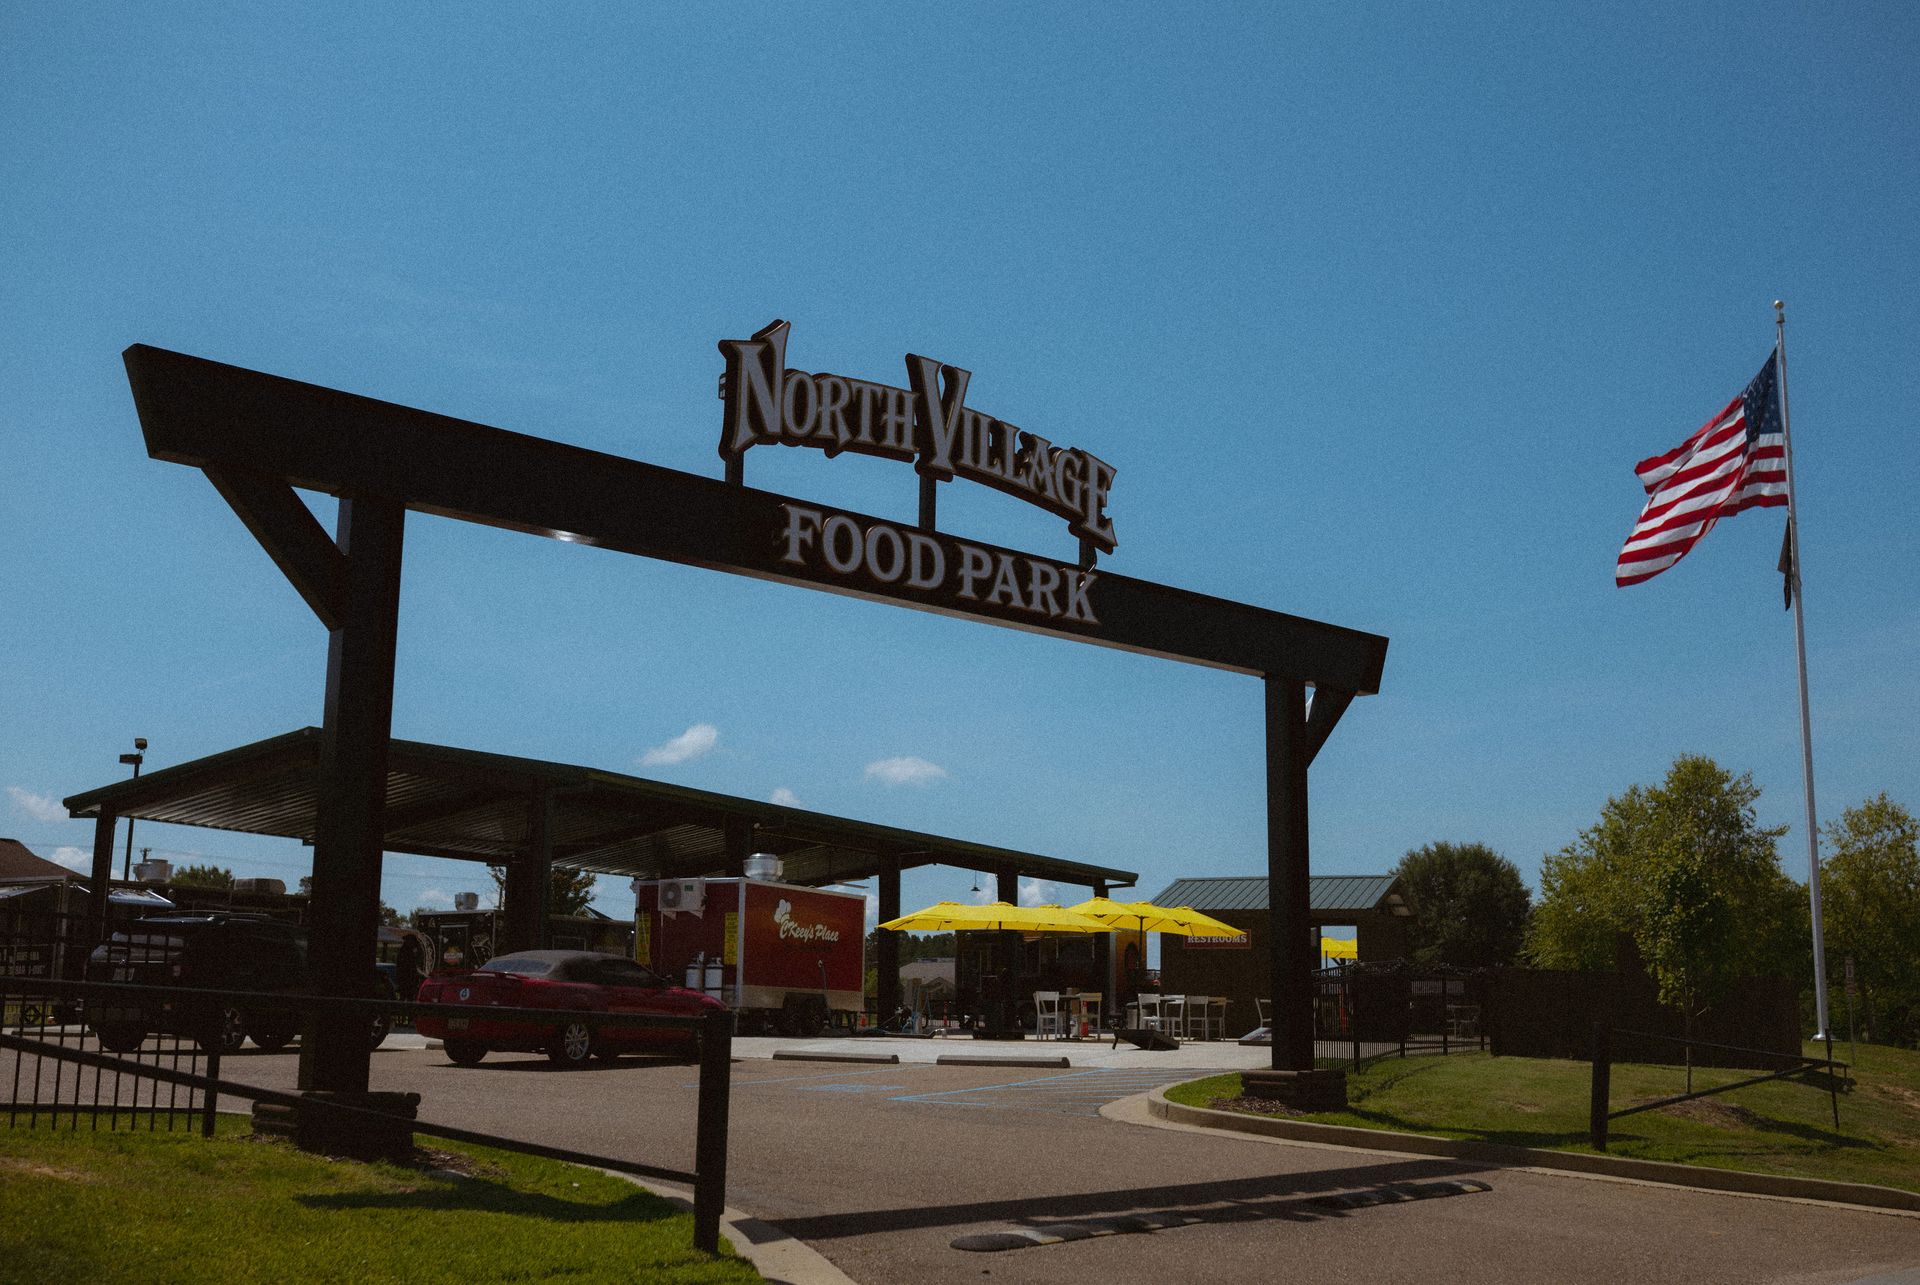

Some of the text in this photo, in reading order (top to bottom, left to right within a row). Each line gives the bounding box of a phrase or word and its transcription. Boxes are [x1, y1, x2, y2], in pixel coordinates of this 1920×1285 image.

[730, 321, 1118, 547] NORTH VILLAGE
[780, 501, 1100, 624] FOOD PARK
[815, 924, 839, 942] Place
